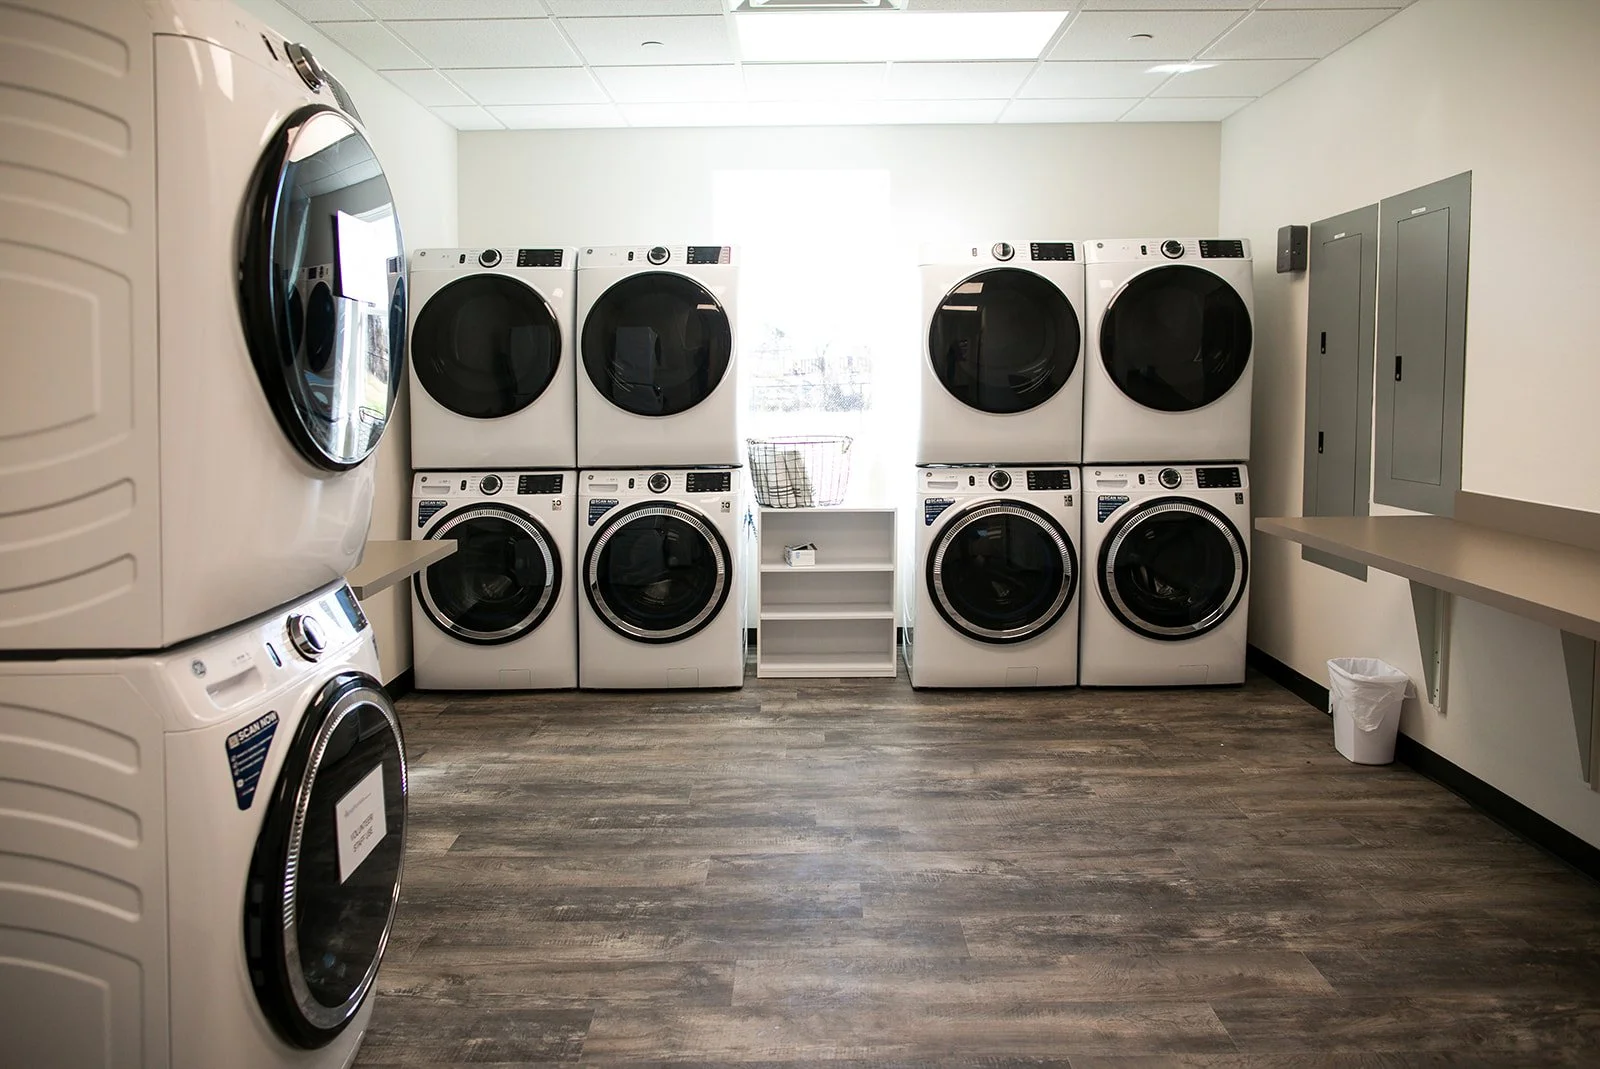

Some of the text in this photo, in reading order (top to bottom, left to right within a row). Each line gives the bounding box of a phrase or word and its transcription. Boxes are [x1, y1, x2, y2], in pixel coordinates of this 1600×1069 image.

[238, 712, 277, 741] SCAN NOW
[350, 812, 374, 842] VOLUNTEER
